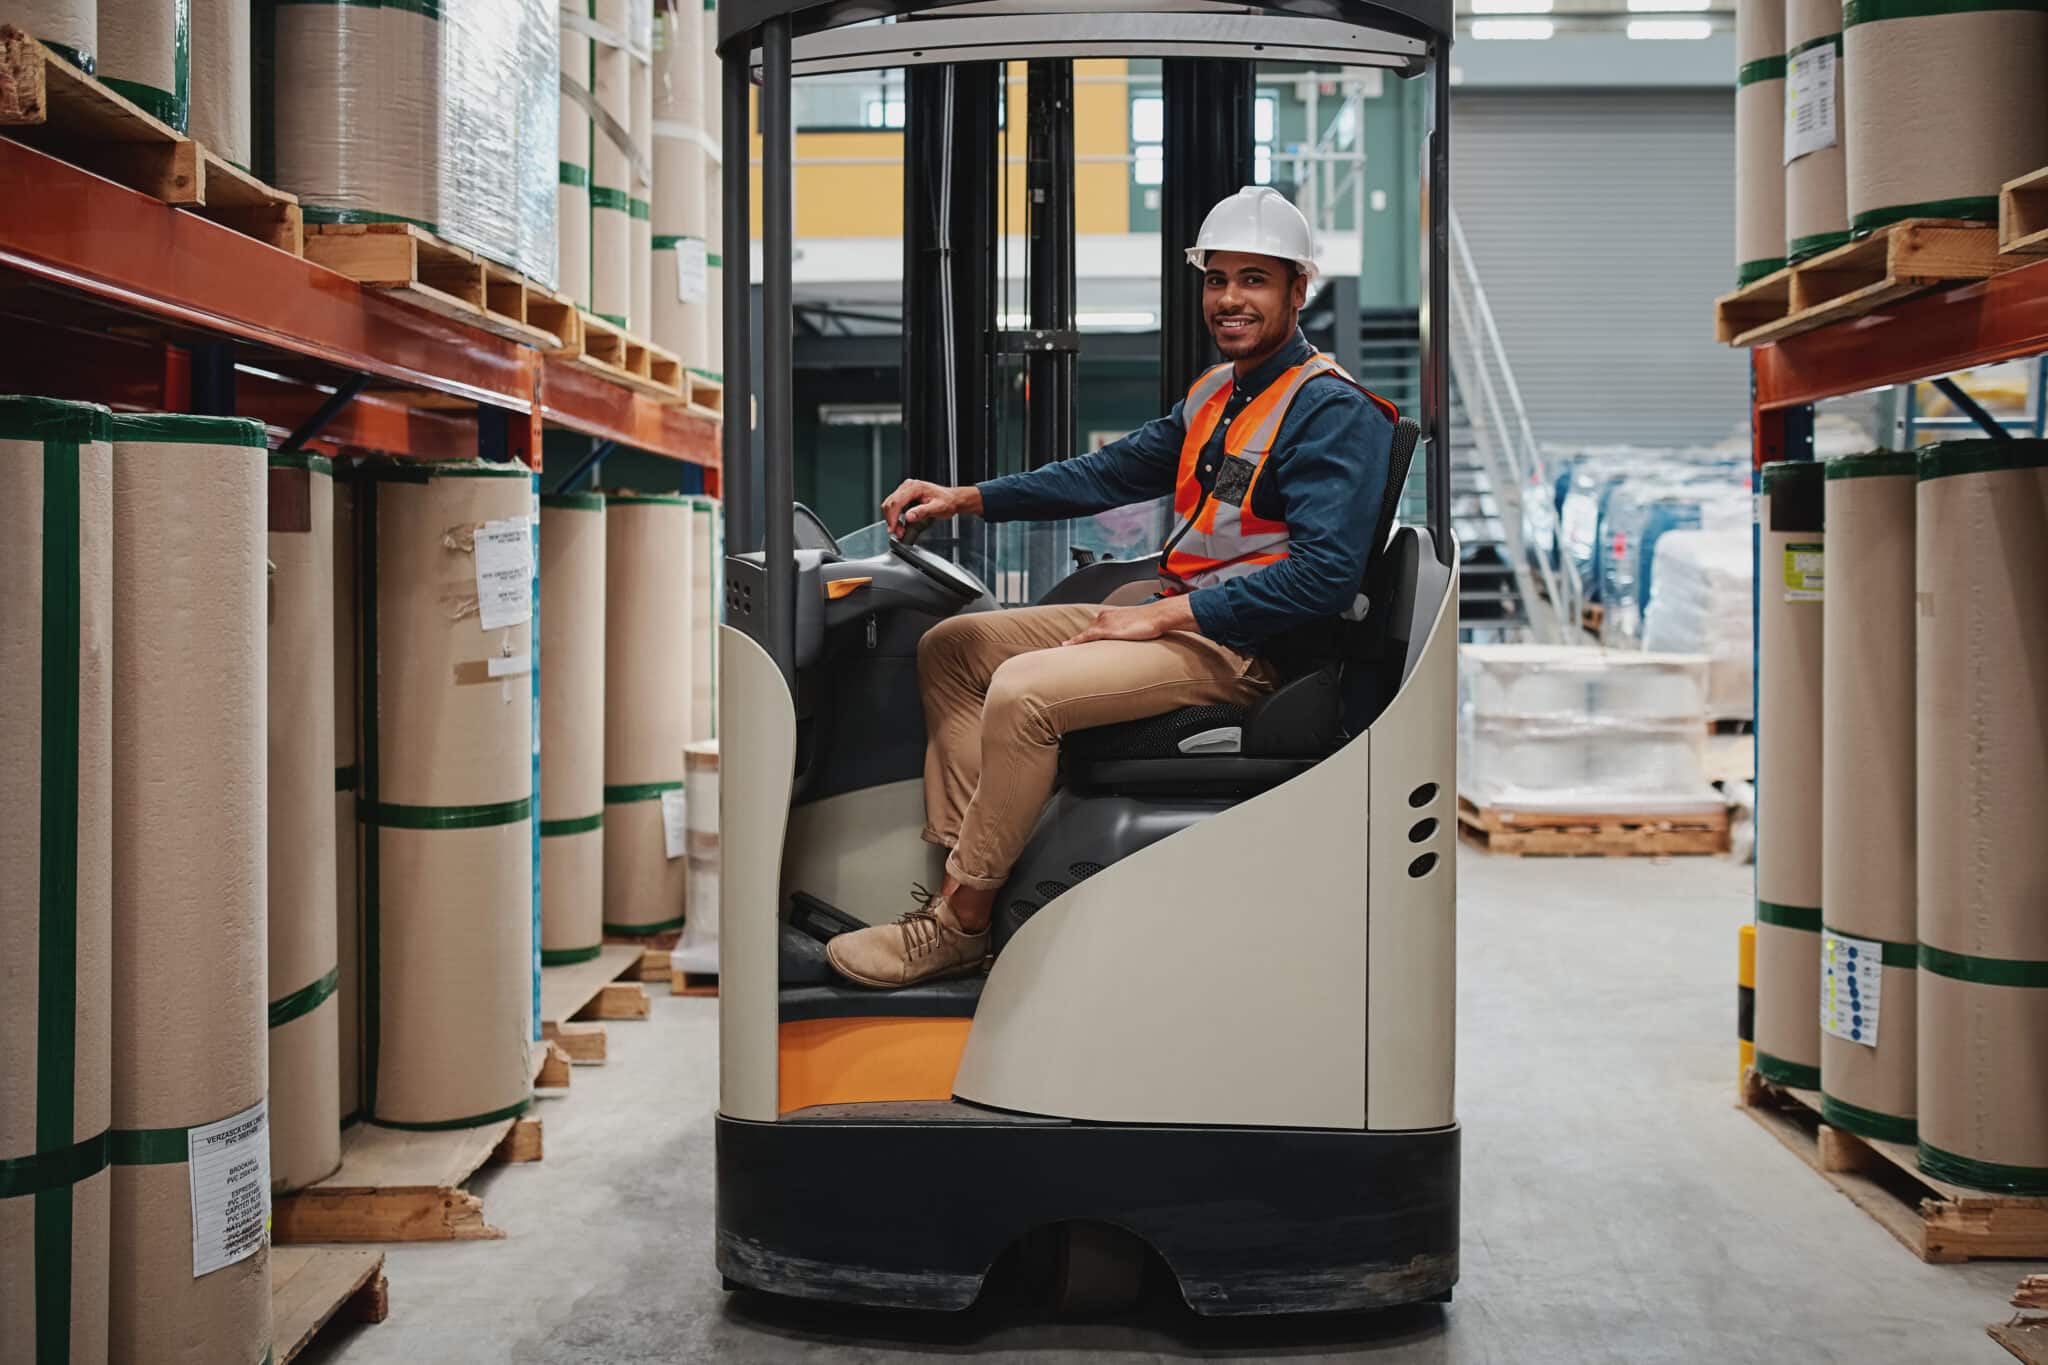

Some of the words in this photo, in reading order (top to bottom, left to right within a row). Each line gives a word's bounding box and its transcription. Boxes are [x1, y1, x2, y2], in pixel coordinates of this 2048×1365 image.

[225, 1135, 237, 1145] PVC
[227, 1174, 239, 1184] PVC
[228, 1196, 239, 1207] PVC
[227, 1213, 239, 1224] PVC
